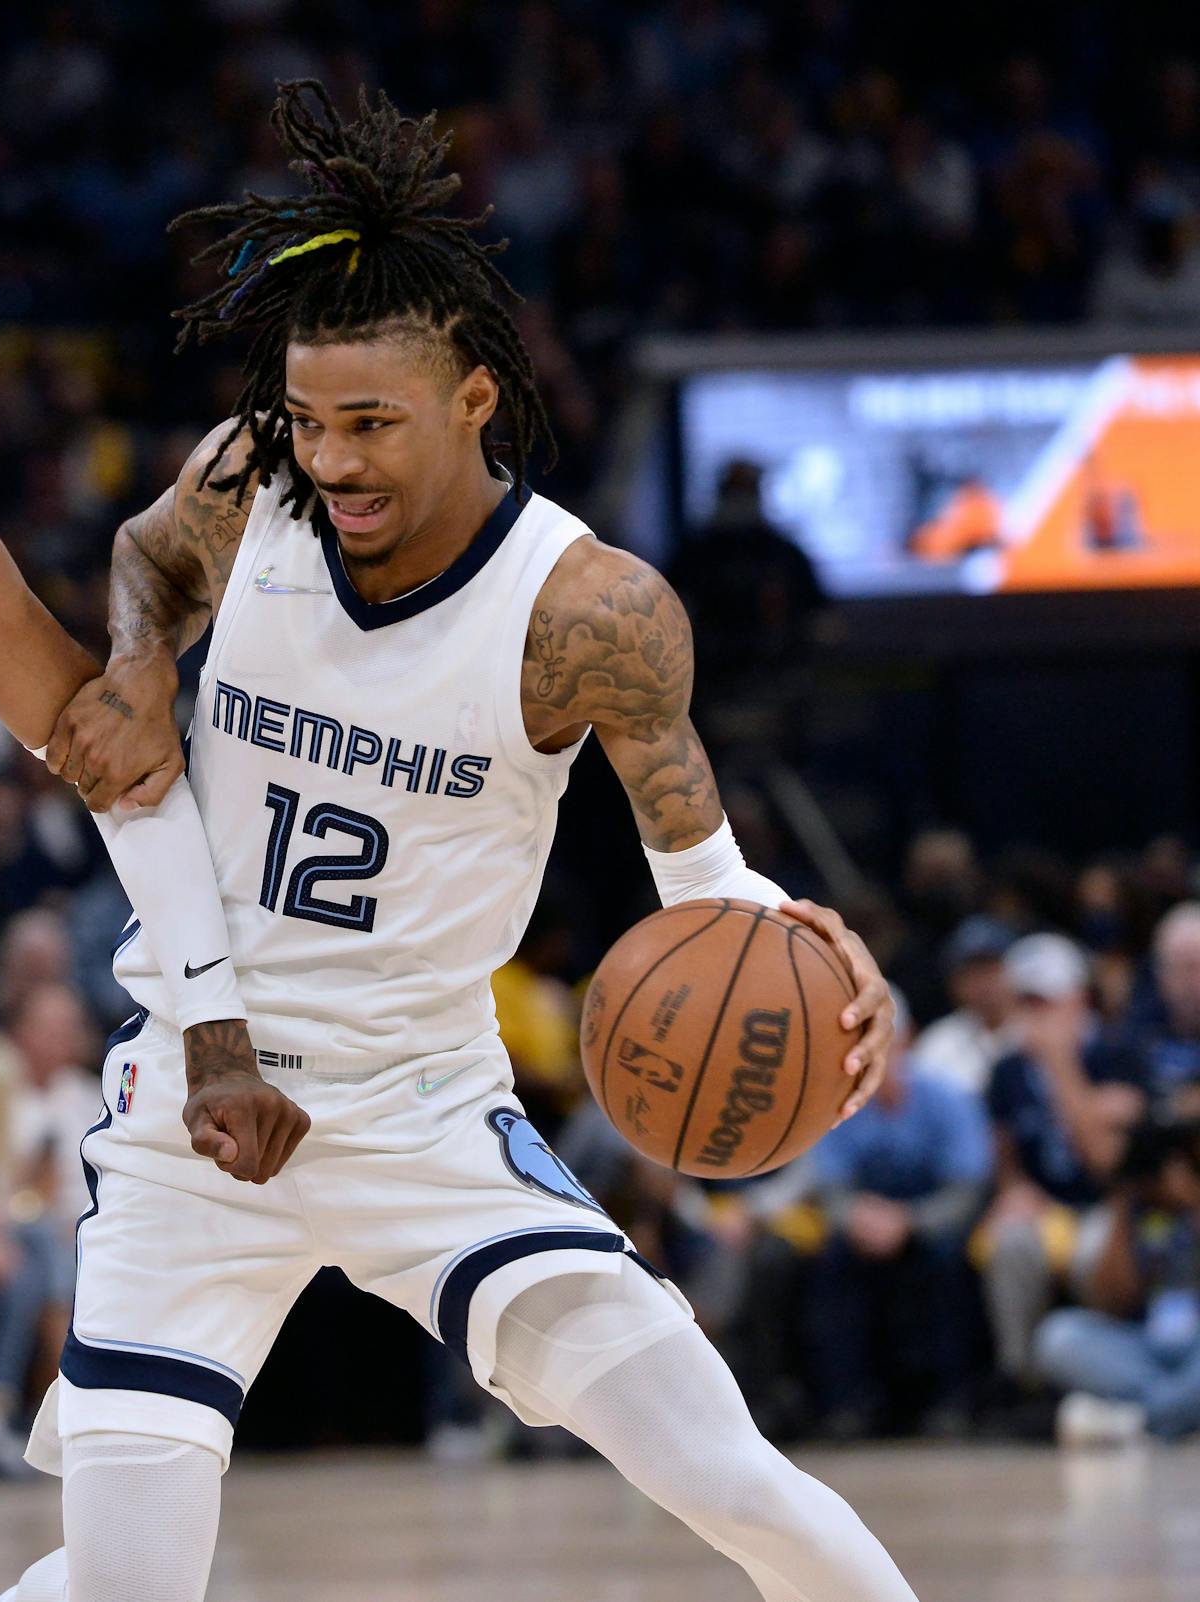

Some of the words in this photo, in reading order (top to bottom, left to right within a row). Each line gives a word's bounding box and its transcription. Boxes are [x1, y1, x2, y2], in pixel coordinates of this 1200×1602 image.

[212, 678, 491, 798] MEMPHIS
[259, 782, 389, 932] 12
[697, 1008, 791, 1166] Wilson
